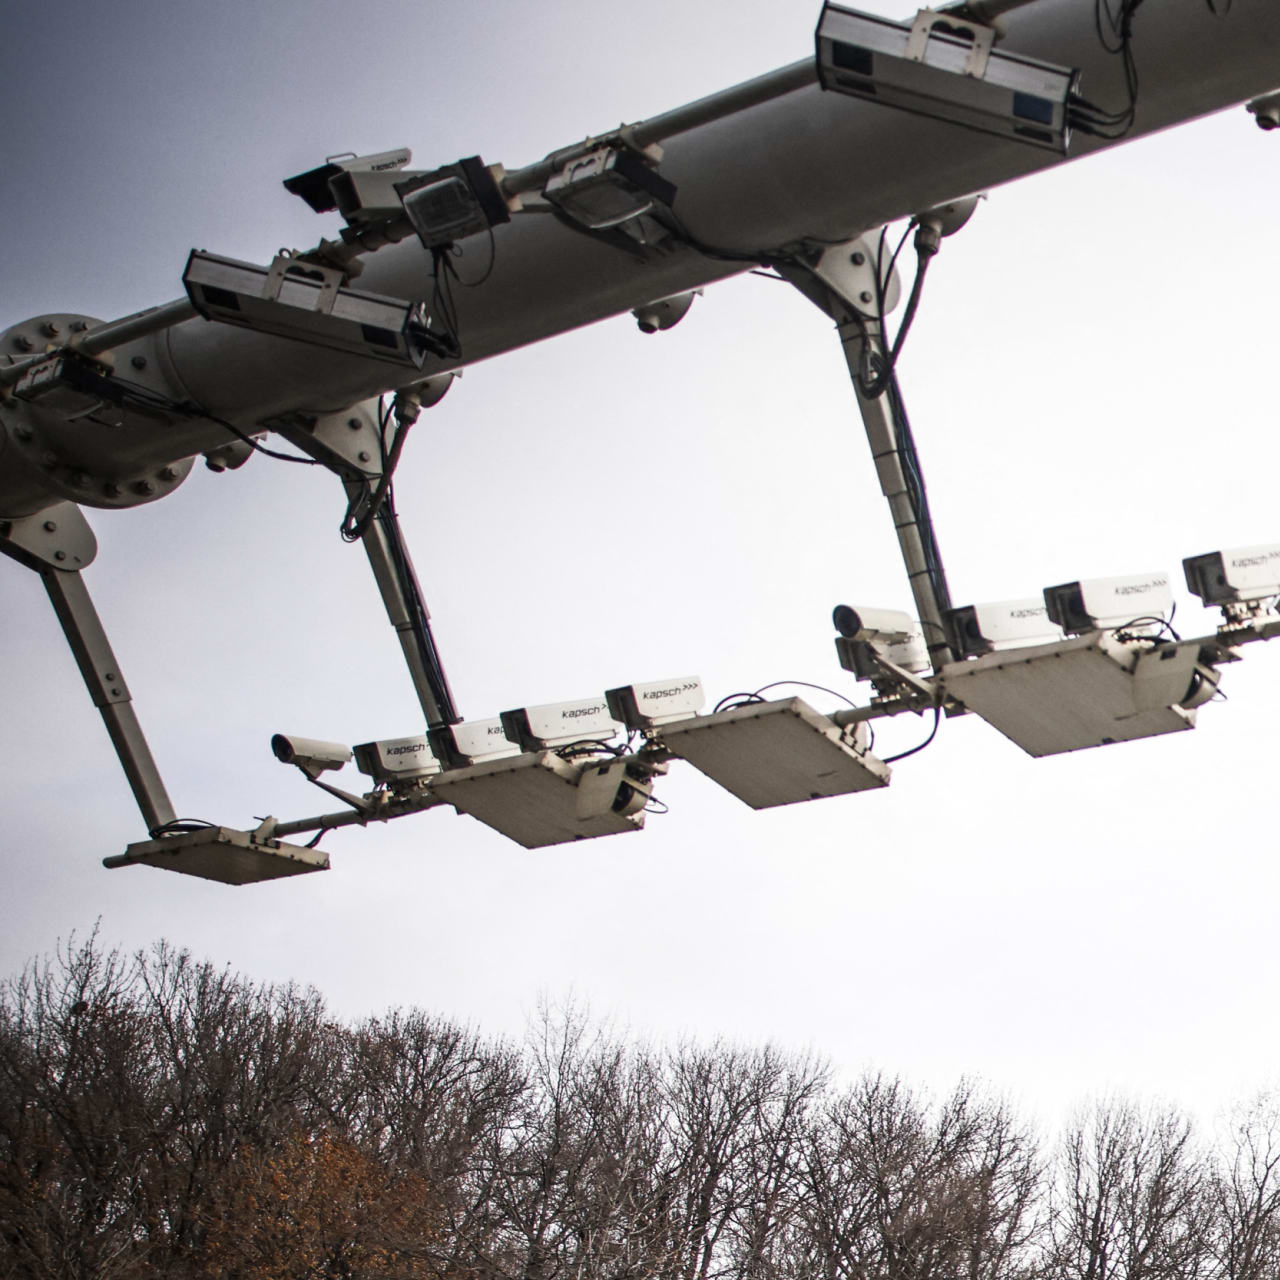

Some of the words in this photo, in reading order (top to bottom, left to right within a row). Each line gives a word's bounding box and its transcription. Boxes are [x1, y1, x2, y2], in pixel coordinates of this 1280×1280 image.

[643, 687, 681, 700] kapsch
[562, 705, 600, 719] kapsch
[386, 743, 425, 756] kapsch
